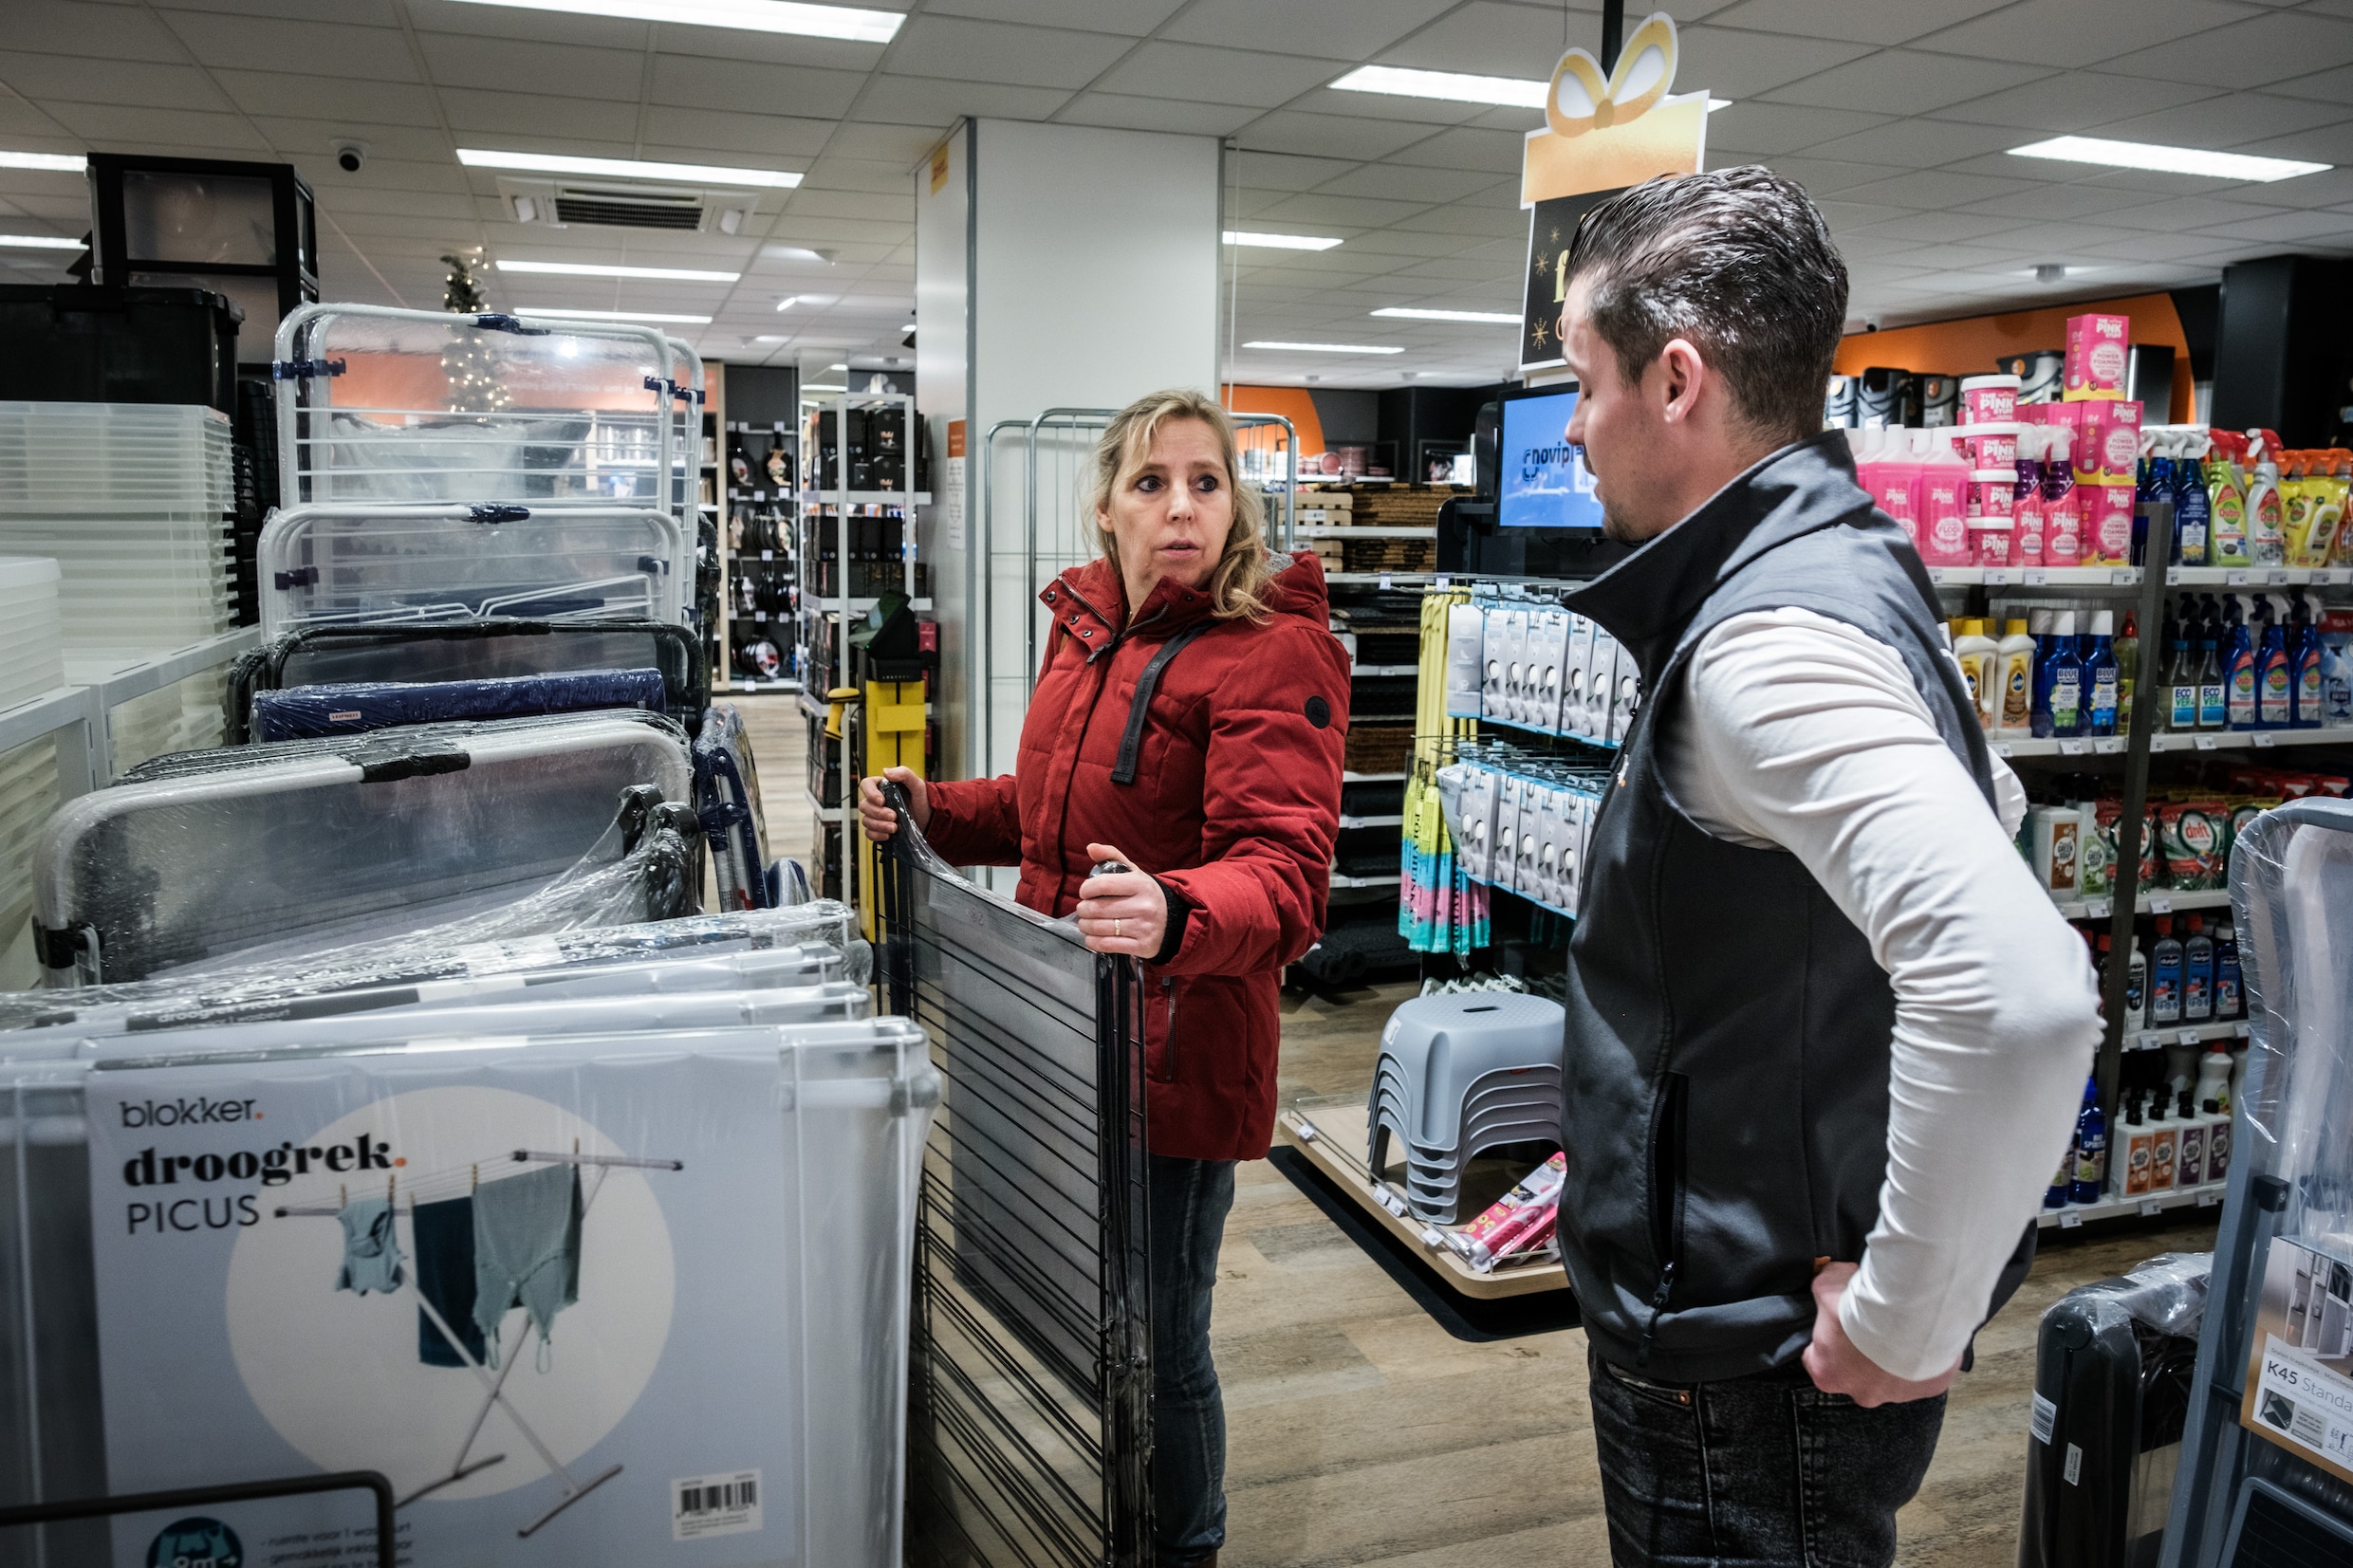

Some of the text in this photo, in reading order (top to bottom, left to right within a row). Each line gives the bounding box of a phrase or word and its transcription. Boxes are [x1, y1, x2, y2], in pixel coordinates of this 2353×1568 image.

[1980, 397, 2014, 410] PINK
[1983, 445, 2015, 457] PINK
[1991, 492, 2014, 504] PIN
[1982, 540, 2010, 550] PIN
[2176, 689, 2191, 698] ECO
[2203, 687, 2220, 696] ECO
[119, 1097, 264, 1128] blokker.
[122, 1133, 407, 1187] droogrek.
[128, 1194, 259, 1234] PICUS
[2270, 1347, 2289, 1359] Stalen
[2268, 1360, 2298, 1385] K45
